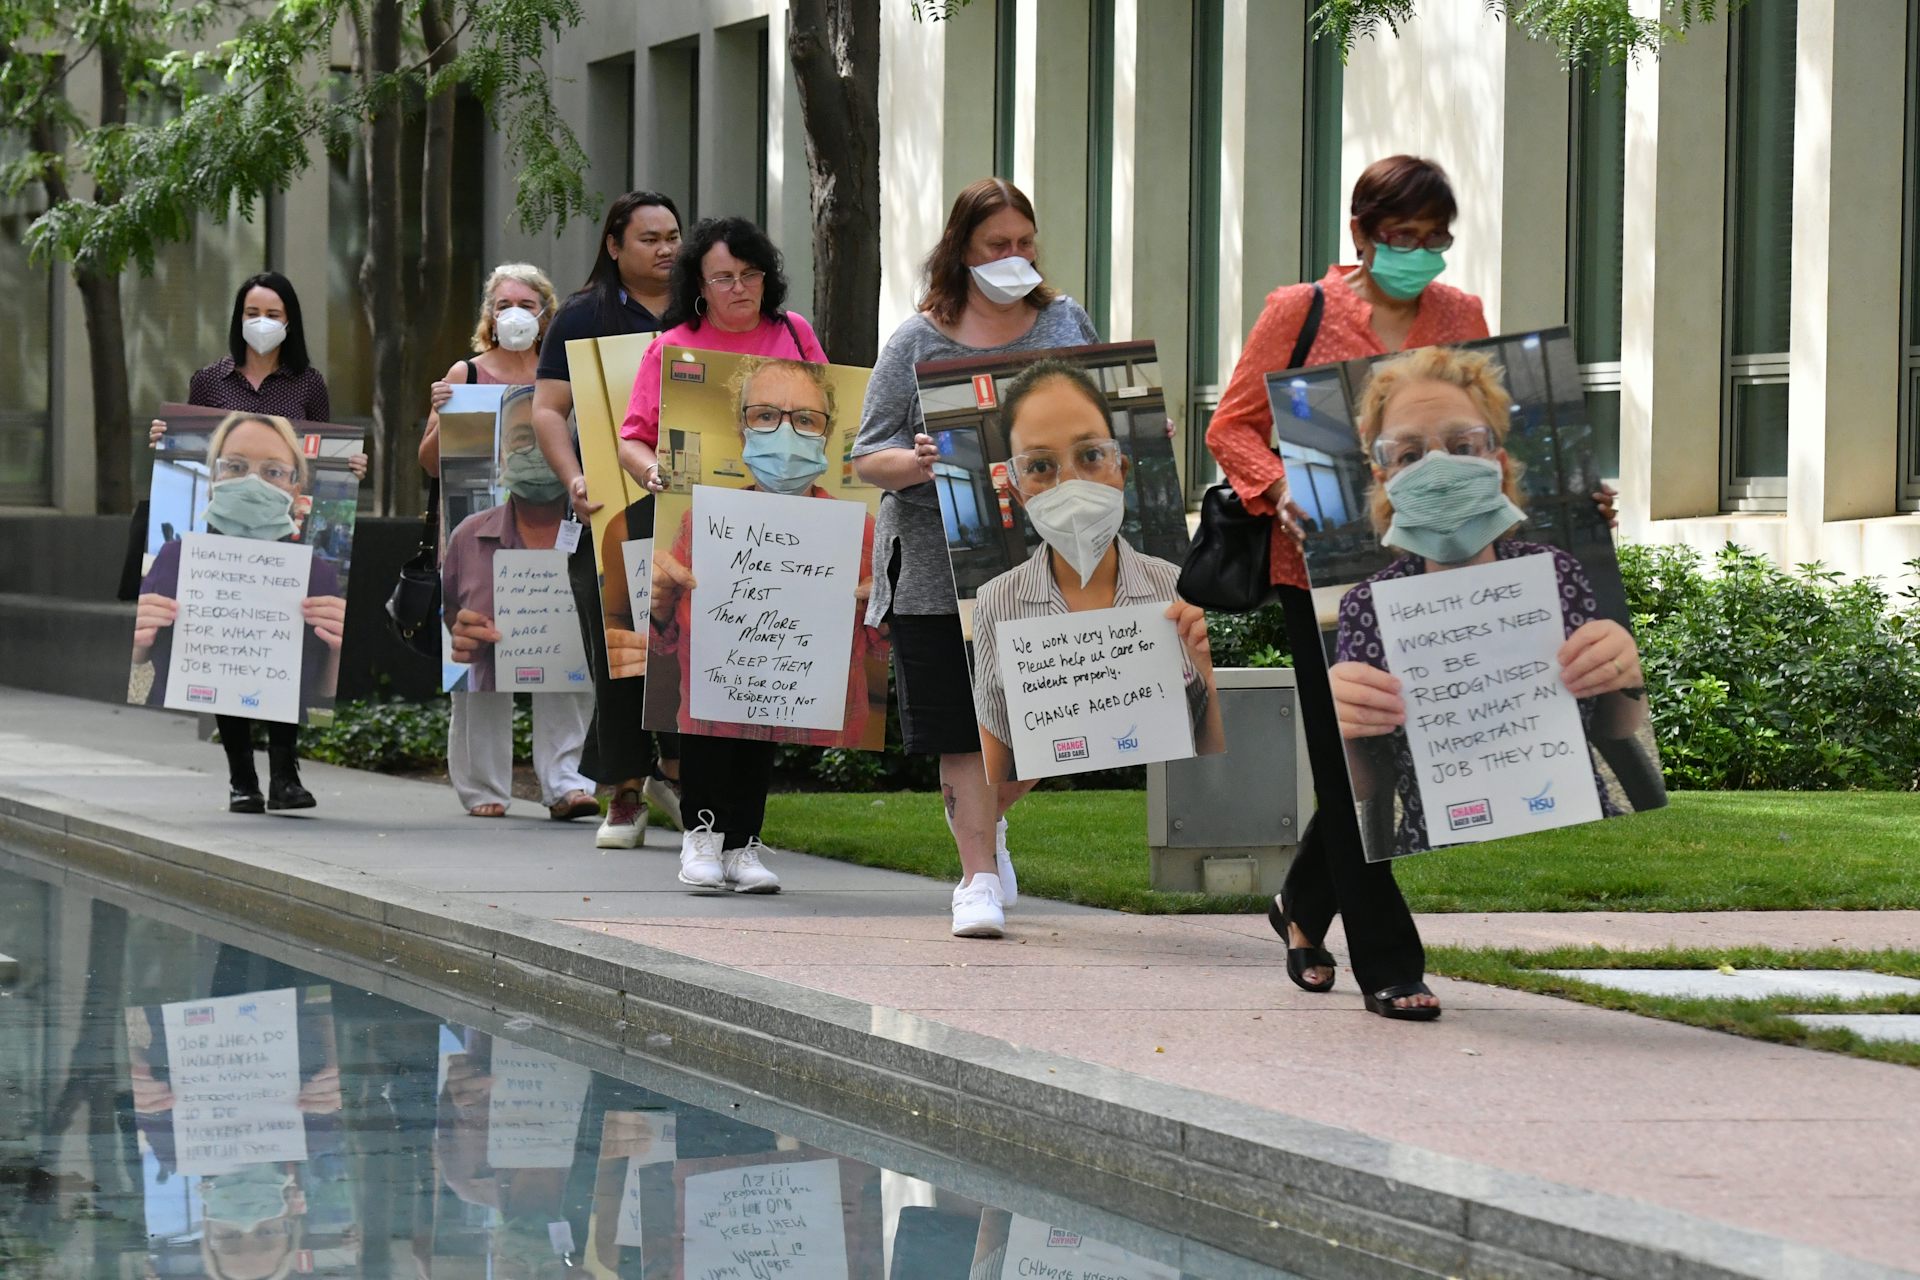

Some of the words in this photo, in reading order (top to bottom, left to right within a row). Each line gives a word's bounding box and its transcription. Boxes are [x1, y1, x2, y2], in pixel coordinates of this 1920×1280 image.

[708, 516, 735, 540] WE
[746, 523, 800, 547] NEED
[191, 547, 243, 564] HEALTH
[248, 554, 286, 568] CARE
[730, 548, 772, 574] MORE
[780, 561, 835, 577] STAFF
[499, 566, 507, 578] A
[635, 560, 646, 576] A
[190, 569, 256, 585] WORKERS
[262, 575, 300, 588] NEED
[186, 588, 204, 600] TO
[216, 588, 242, 600] BE
[1390, 594, 1462, 622] HEALTH
[1470, 582, 1524, 604] CARE
[186, 604, 290, 622] RECOGNISED
[755, 610, 800, 630] MORE
[184, 624, 214, 638] FOR
[222, 627, 266, 640] WHAT
[272, 629, 291, 641] AN
[512, 624, 548, 638] WAGE
[738, 626, 786, 650] MONEY
[1397, 622, 1492, 653] WORKERS
[1497, 608, 1552, 634] NEED
[185, 642, 272, 658] IMPORTANT
[500, 644, 561, 658] INCREASE
[1012, 637, 1032, 654] We
[1042, 632, 1069, 650] work
[1074, 629, 1104, 645] very
[180, 658, 212, 674] JOB
[220, 662, 261, 677] THEY
[726, 649, 768, 667] KEEP
[772, 656, 813, 678] THEM
[1018, 657, 1056, 675] Please
[1059, 652, 1086, 668] help
[1403, 666, 1429, 682] TO
[1442, 652, 1480, 674] BE
[772, 680, 798, 690] OUR
[1410, 660, 1550, 707] RECOGNISED
[1024, 703, 1080, 731] CHANGE
[1418, 711, 1460, 733] FOR
[1468, 694, 1526, 723] WHAT
[1532, 683, 1558, 700] AN
[1056, 740, 1084, 752] CHANGE
[1118, 738, 1138, 750] HSU
[1428, 715, 1542, 758] IMPORTANT
[1072, 750, 1086, 758] CARE
[1432, 761, 1473, 784] JOB
[1479, 747, 1532, 773] THEY
[1451, 803, 1485, 818] CHANGE
[1528, 797, 1555, 812] HSU
